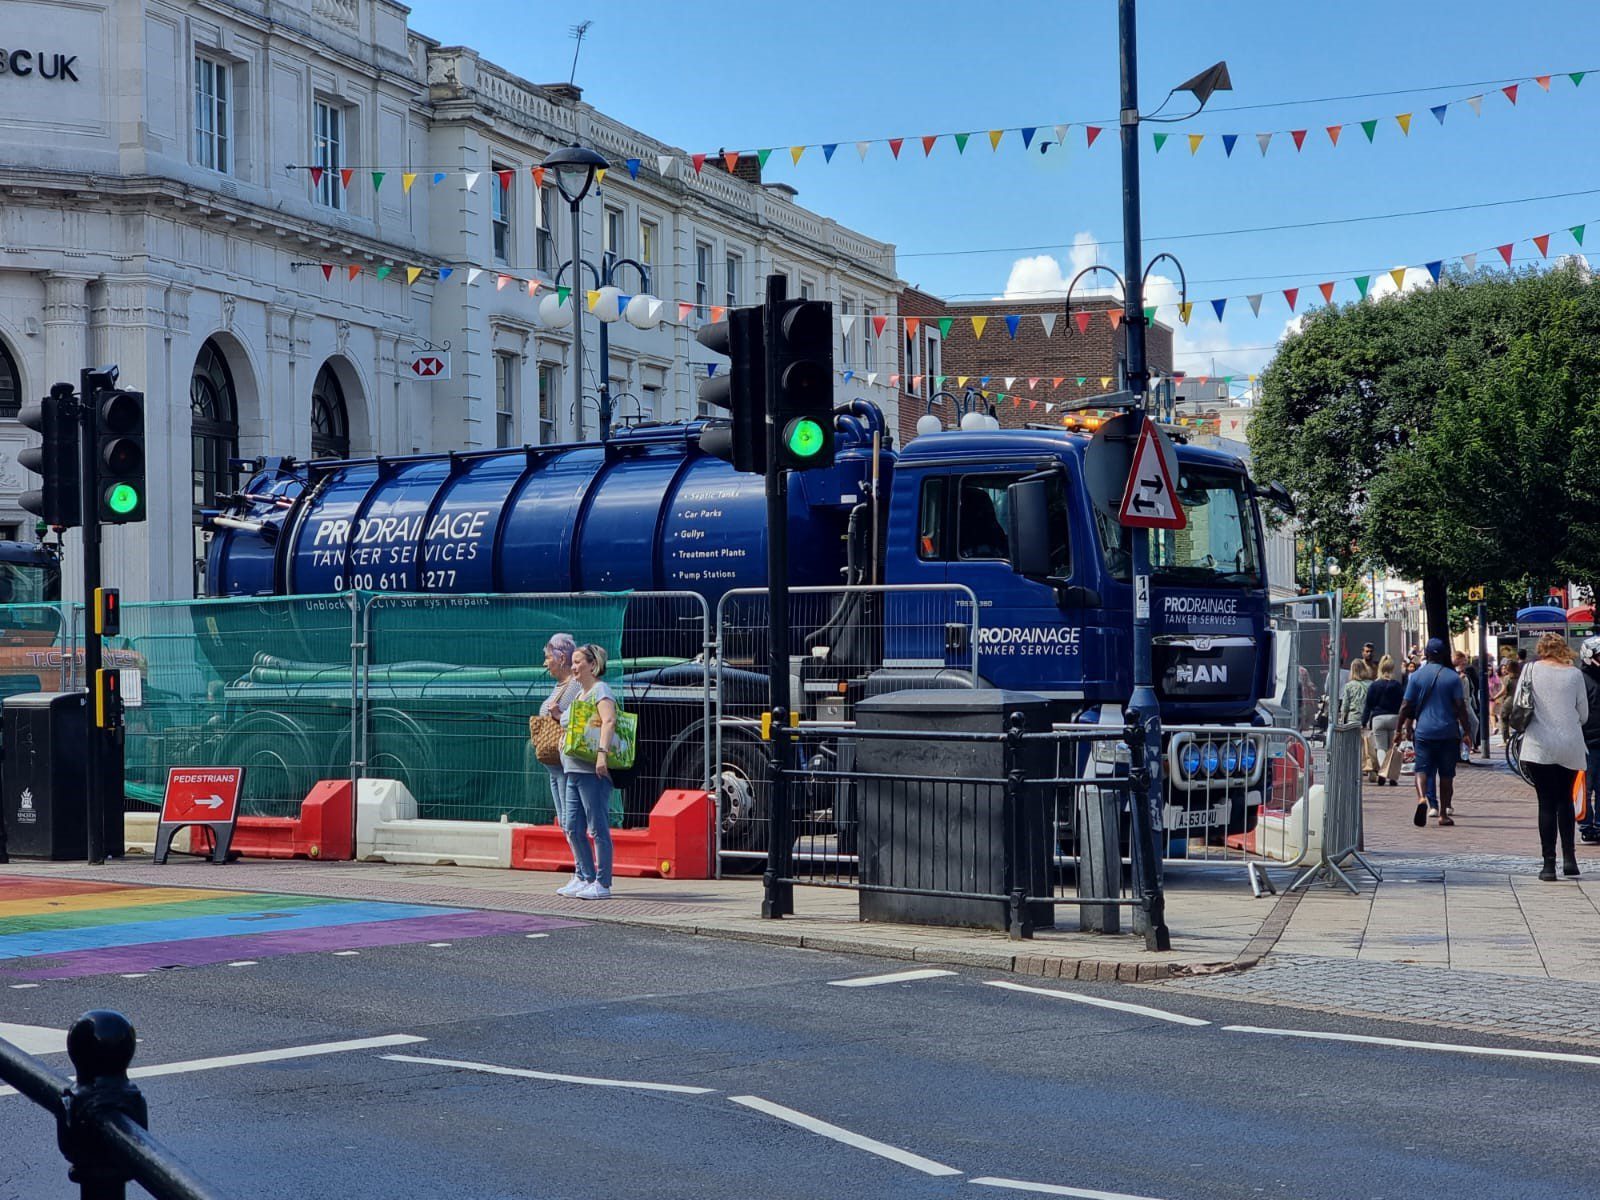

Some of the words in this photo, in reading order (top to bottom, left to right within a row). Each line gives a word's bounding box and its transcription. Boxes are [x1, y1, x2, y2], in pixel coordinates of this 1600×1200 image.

[38, 51, 79, 82] UK
[684, 510, 698, 518] Car
[701, 509, 722, 518] Parks
[681, 529, 705, 540] Gullys
[313, 547, 382, 567] TANKER
[679, 550, 719, 559] Treatment
[721, 548, 746, 557] Plants
[334, 573, 373, 591] 000
[380, 572, 407, 590] 611
[421, 570, 456, 588] 277
[679, 571, 700, 580] Pump
[703, 570, 736, 578] Stations
[305, 599, 361, 612] Unblockg
[400, 599, 440, 609] Sureys
[1164, 597, 1238, 614] PRODRAINAGE
[1165, 614, 1197, 625] TANKER
[1200, 615, 1236, 625] SERVICES
[971, 645, 1015, 656] ANKER
[1020, 645, 1079, 656] SERVICES
[1176, 664, 1228, 683] MAN
[173, 774, 235, 784] PEDESTRIANS
